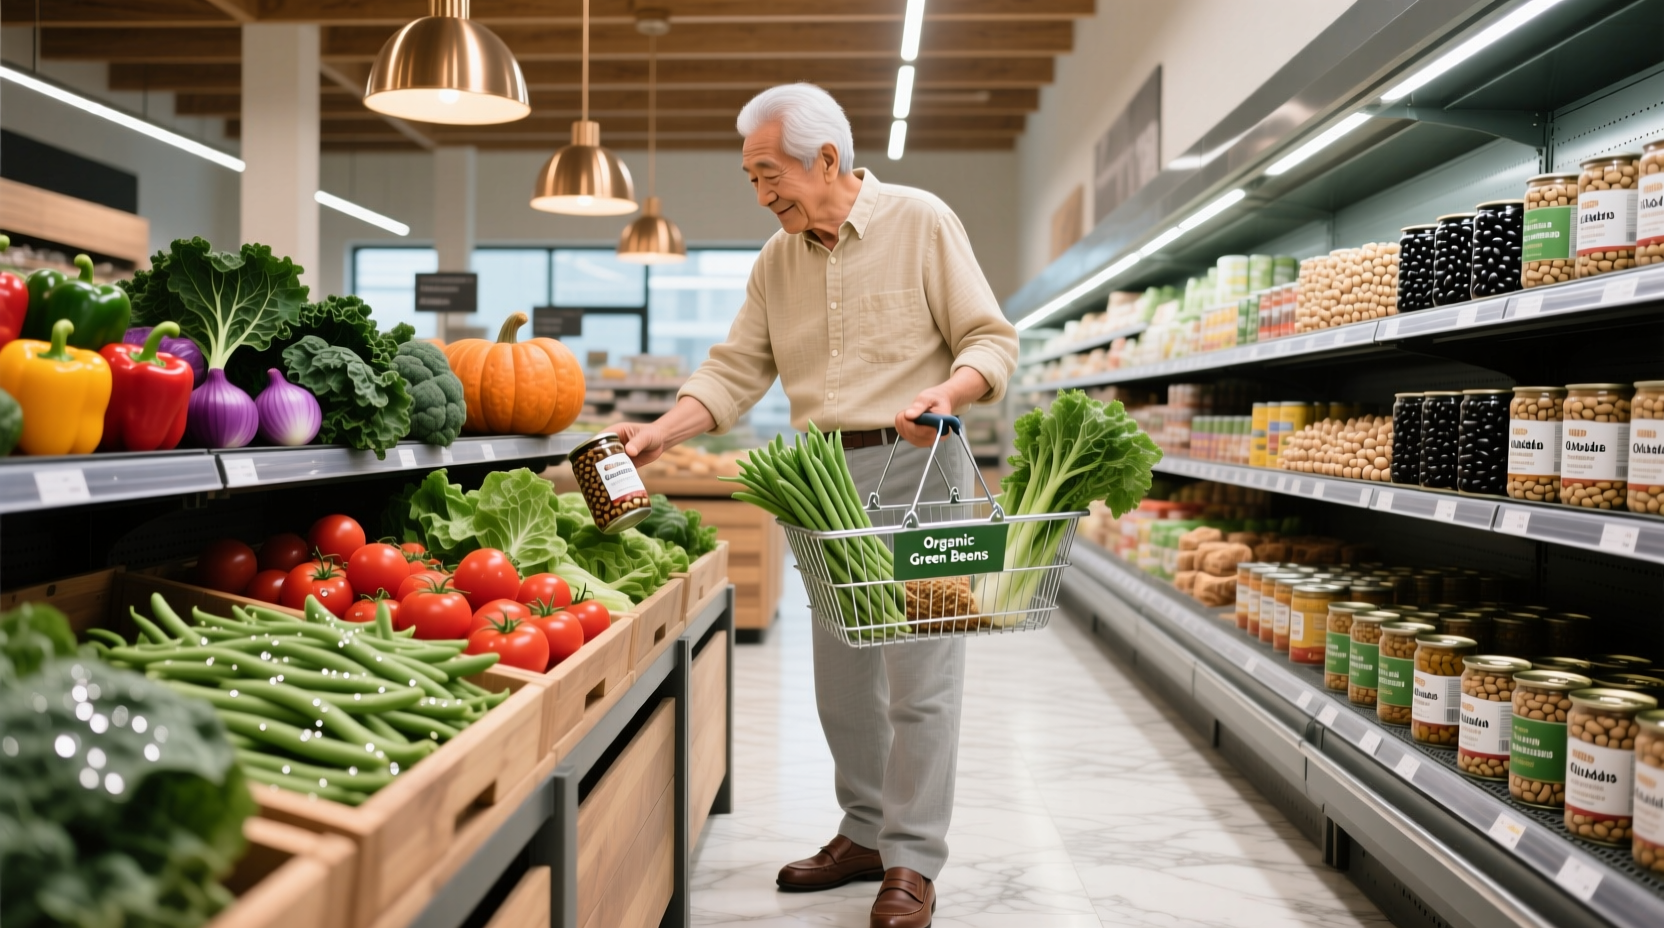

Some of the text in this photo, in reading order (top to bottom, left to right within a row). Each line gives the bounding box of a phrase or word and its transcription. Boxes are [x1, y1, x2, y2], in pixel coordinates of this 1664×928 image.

[924, 533, 975, 552] Organic
[910, 549, 989, 566] Green Beans
